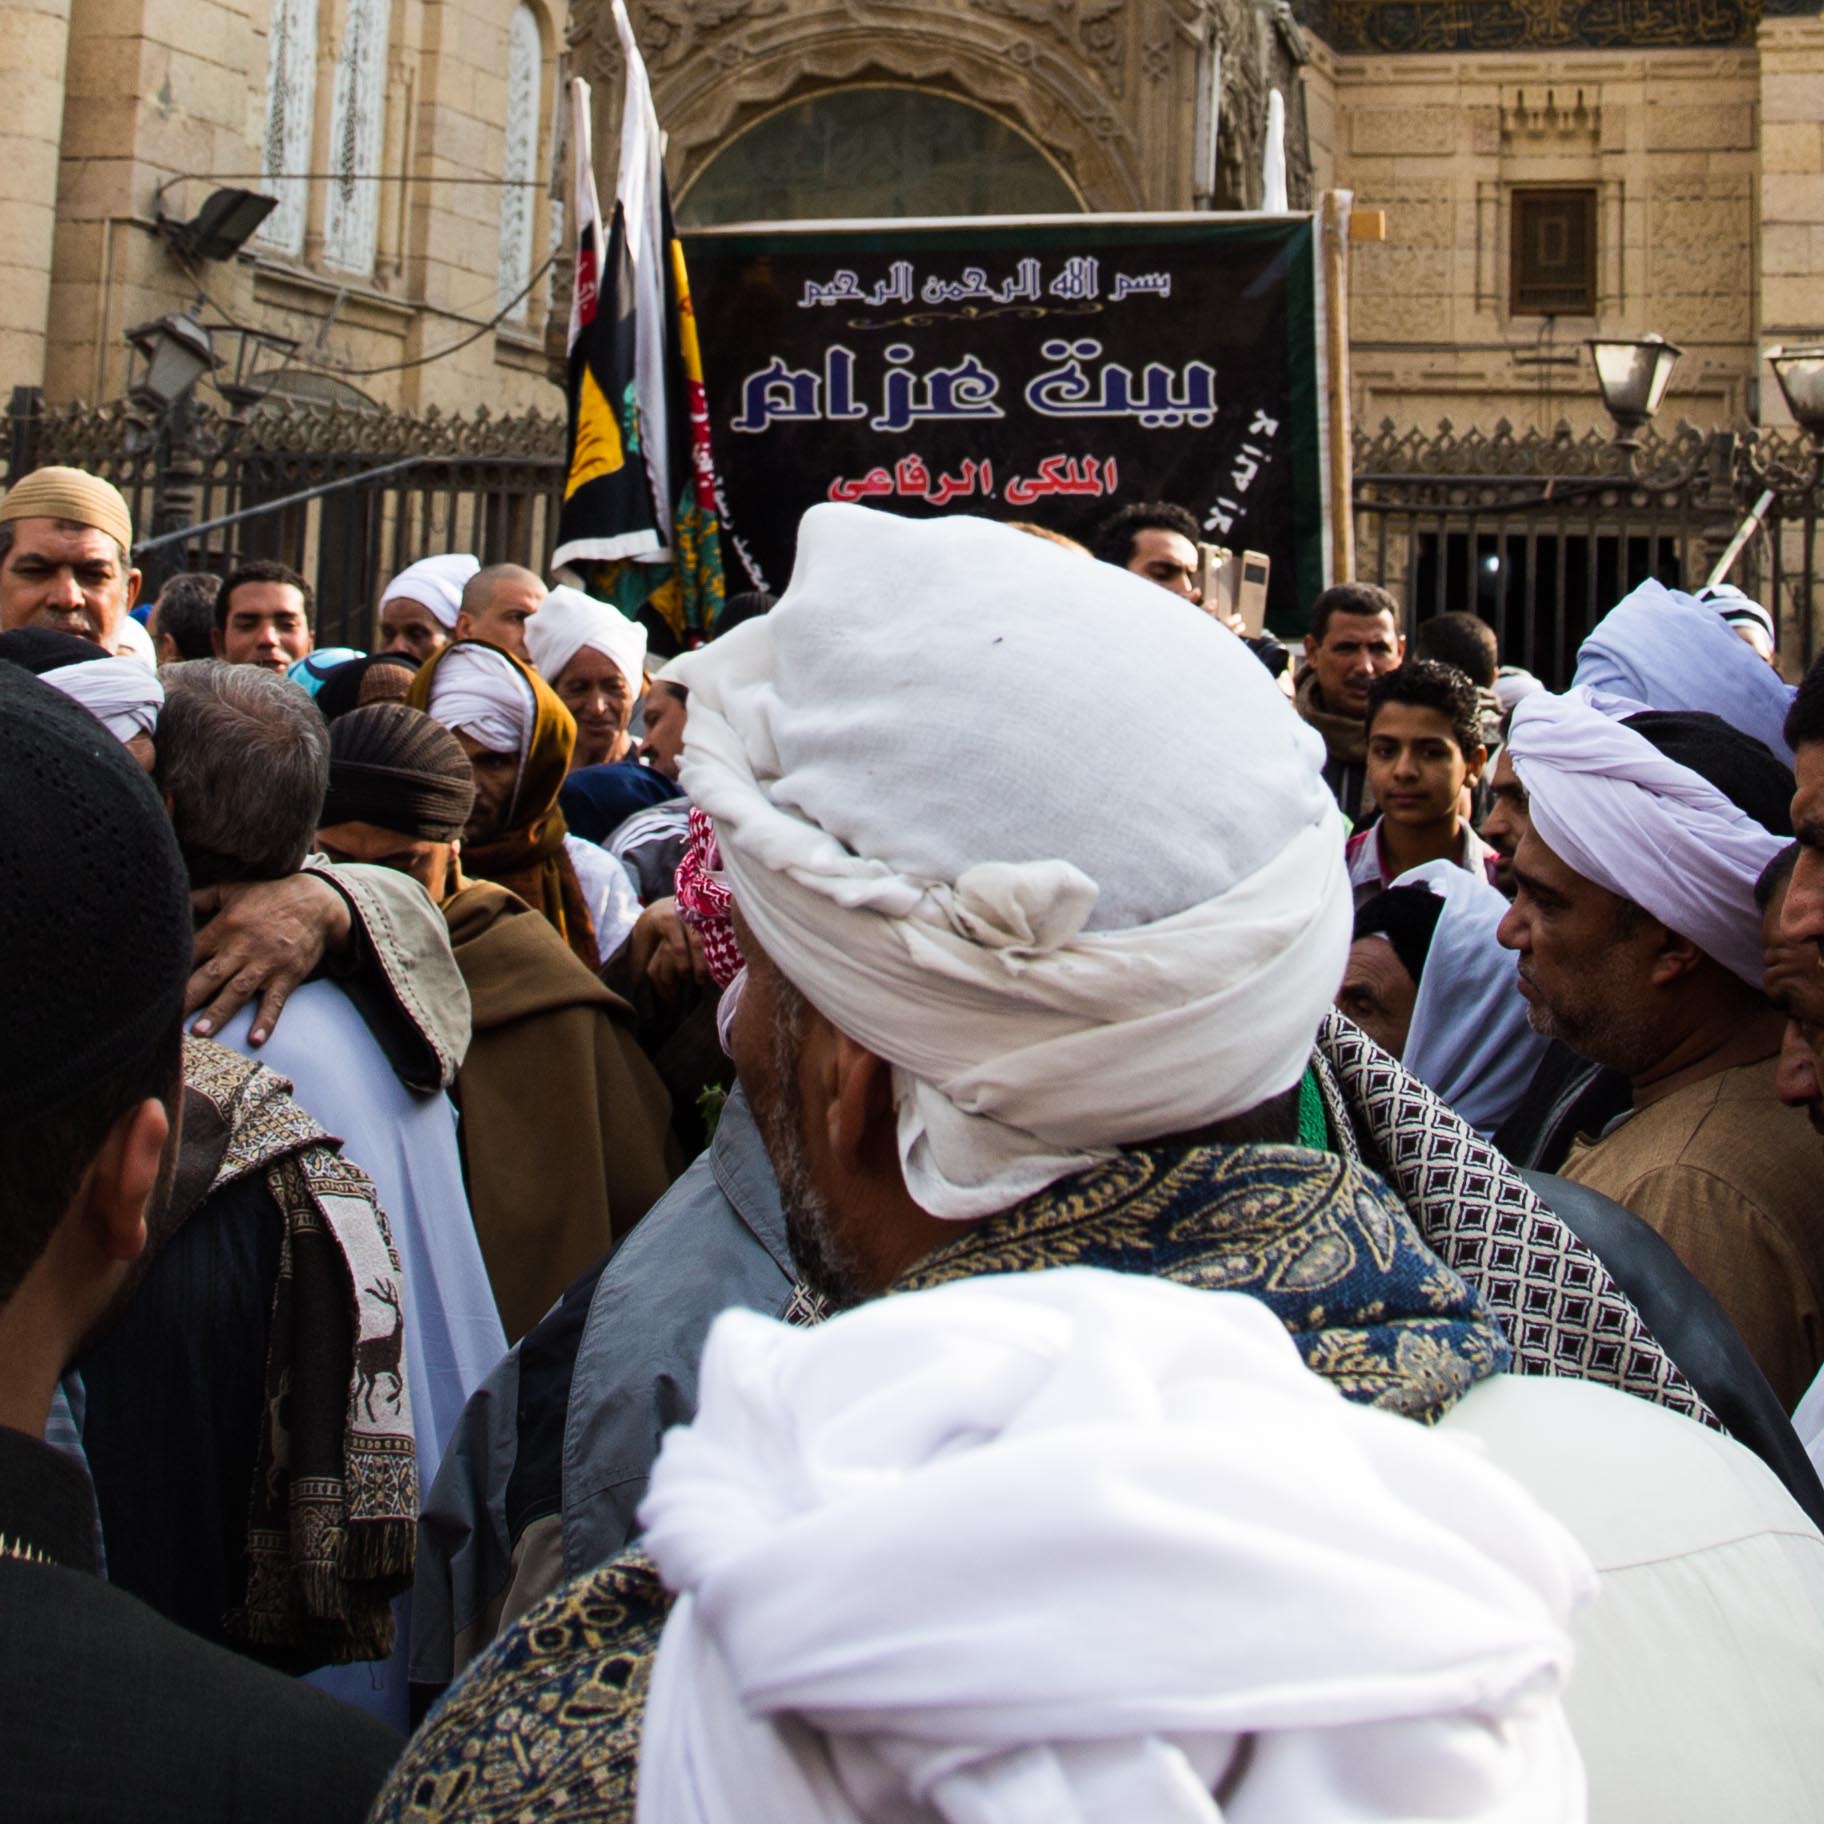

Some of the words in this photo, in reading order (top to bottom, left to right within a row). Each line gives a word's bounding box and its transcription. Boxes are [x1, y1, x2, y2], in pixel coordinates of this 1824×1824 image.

[796, 260, 916, 308] الرحيم
[920, 256, 1042, 305] الرحمن
[1048, 256, 1100, 301] الله
[1108, 271, 1172, 302] بسم
[729, 342, 1007, 435] عزام
[1024, 337, 1218, 430] بيت
[1247, 407, 1280, 439] لا
